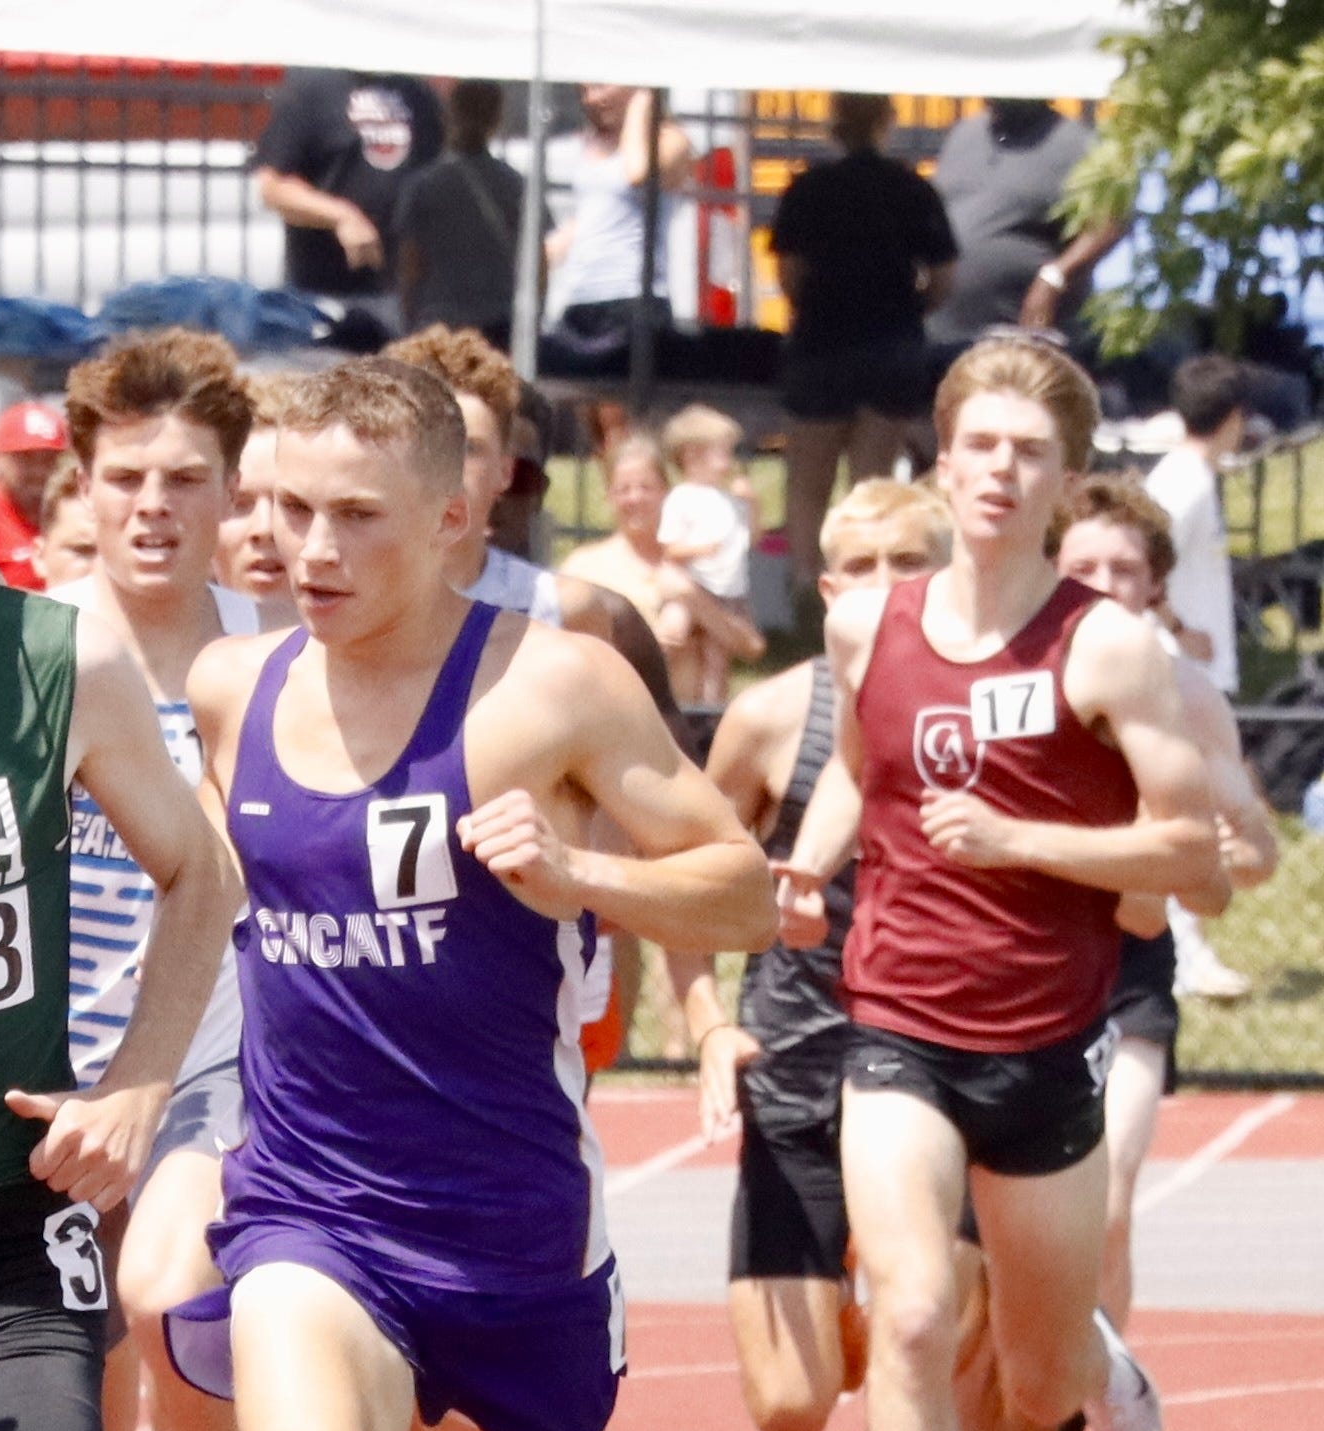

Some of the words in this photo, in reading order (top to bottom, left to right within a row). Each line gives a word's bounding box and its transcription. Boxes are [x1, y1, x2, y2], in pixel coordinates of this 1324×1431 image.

[980, 682, 1036, 734] 17
[379, 805, 431, 899] 7
[54, 1211, 103, 1305] 3
